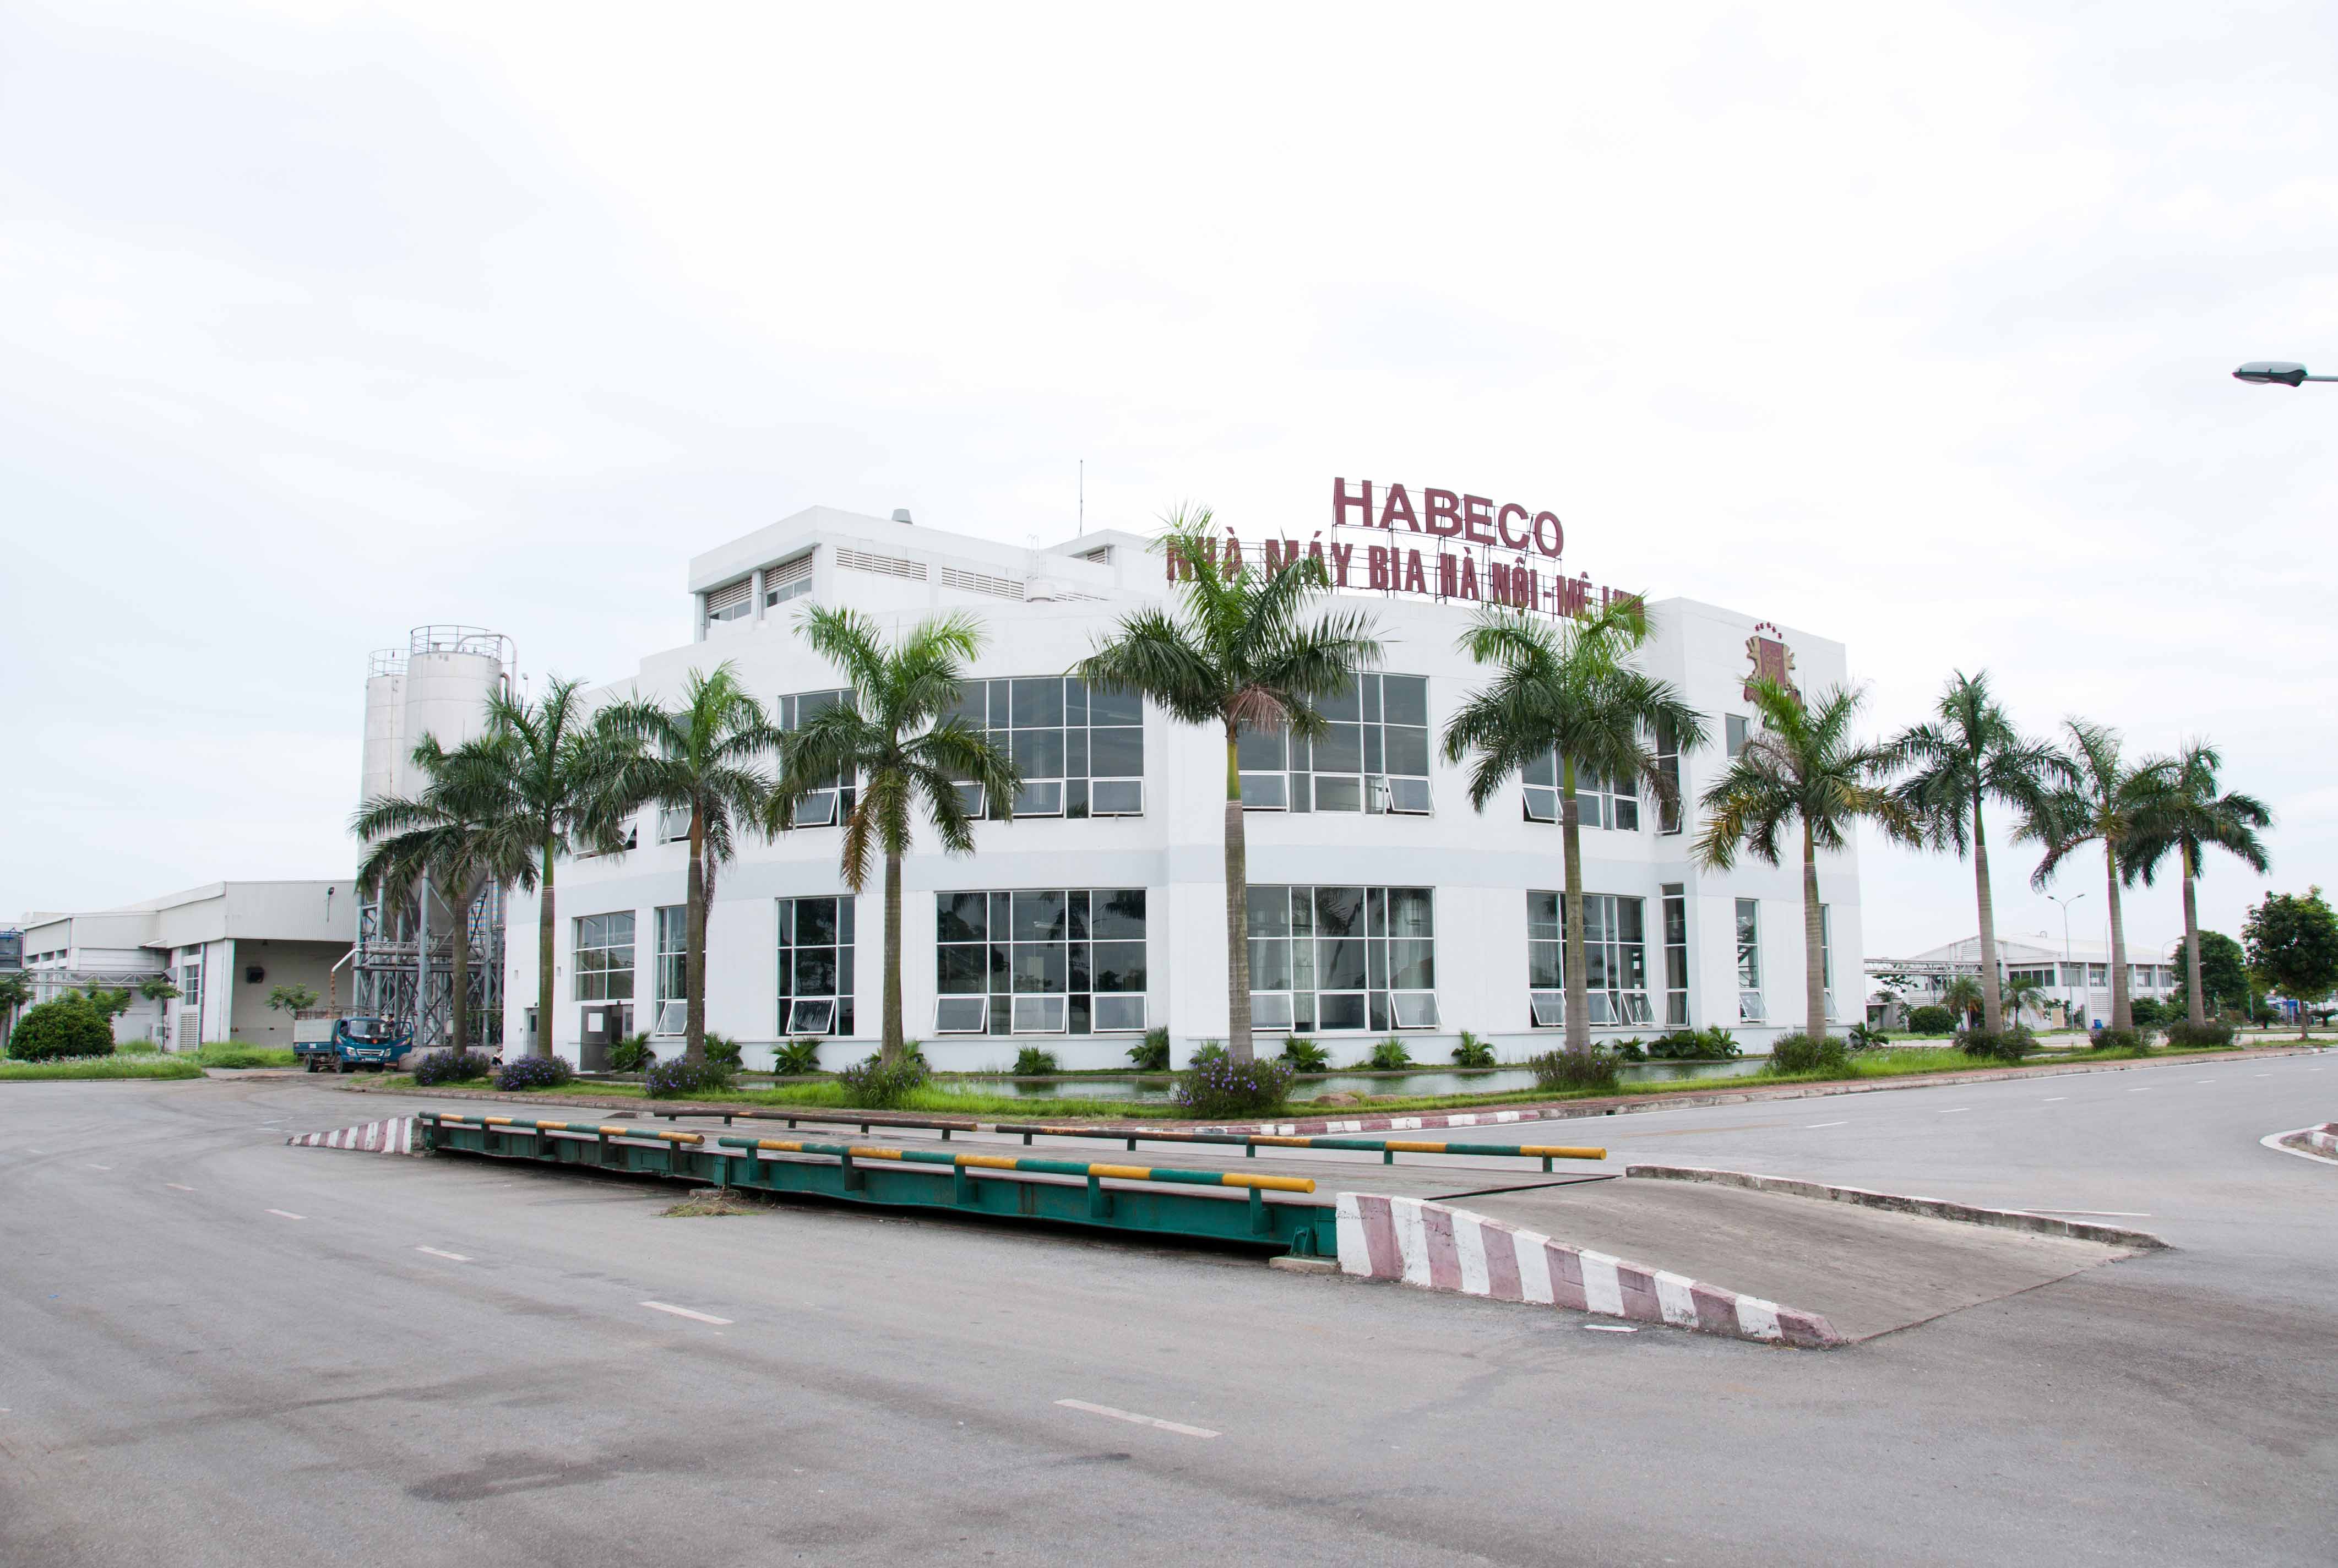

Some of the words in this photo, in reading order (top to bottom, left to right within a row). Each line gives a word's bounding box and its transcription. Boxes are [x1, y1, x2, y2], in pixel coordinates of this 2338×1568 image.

[1334, 477, 1564, 558] HABECO
[1368, 545, 1427, 594] BIA
[1440, 546, 1480, 601] HÀ
